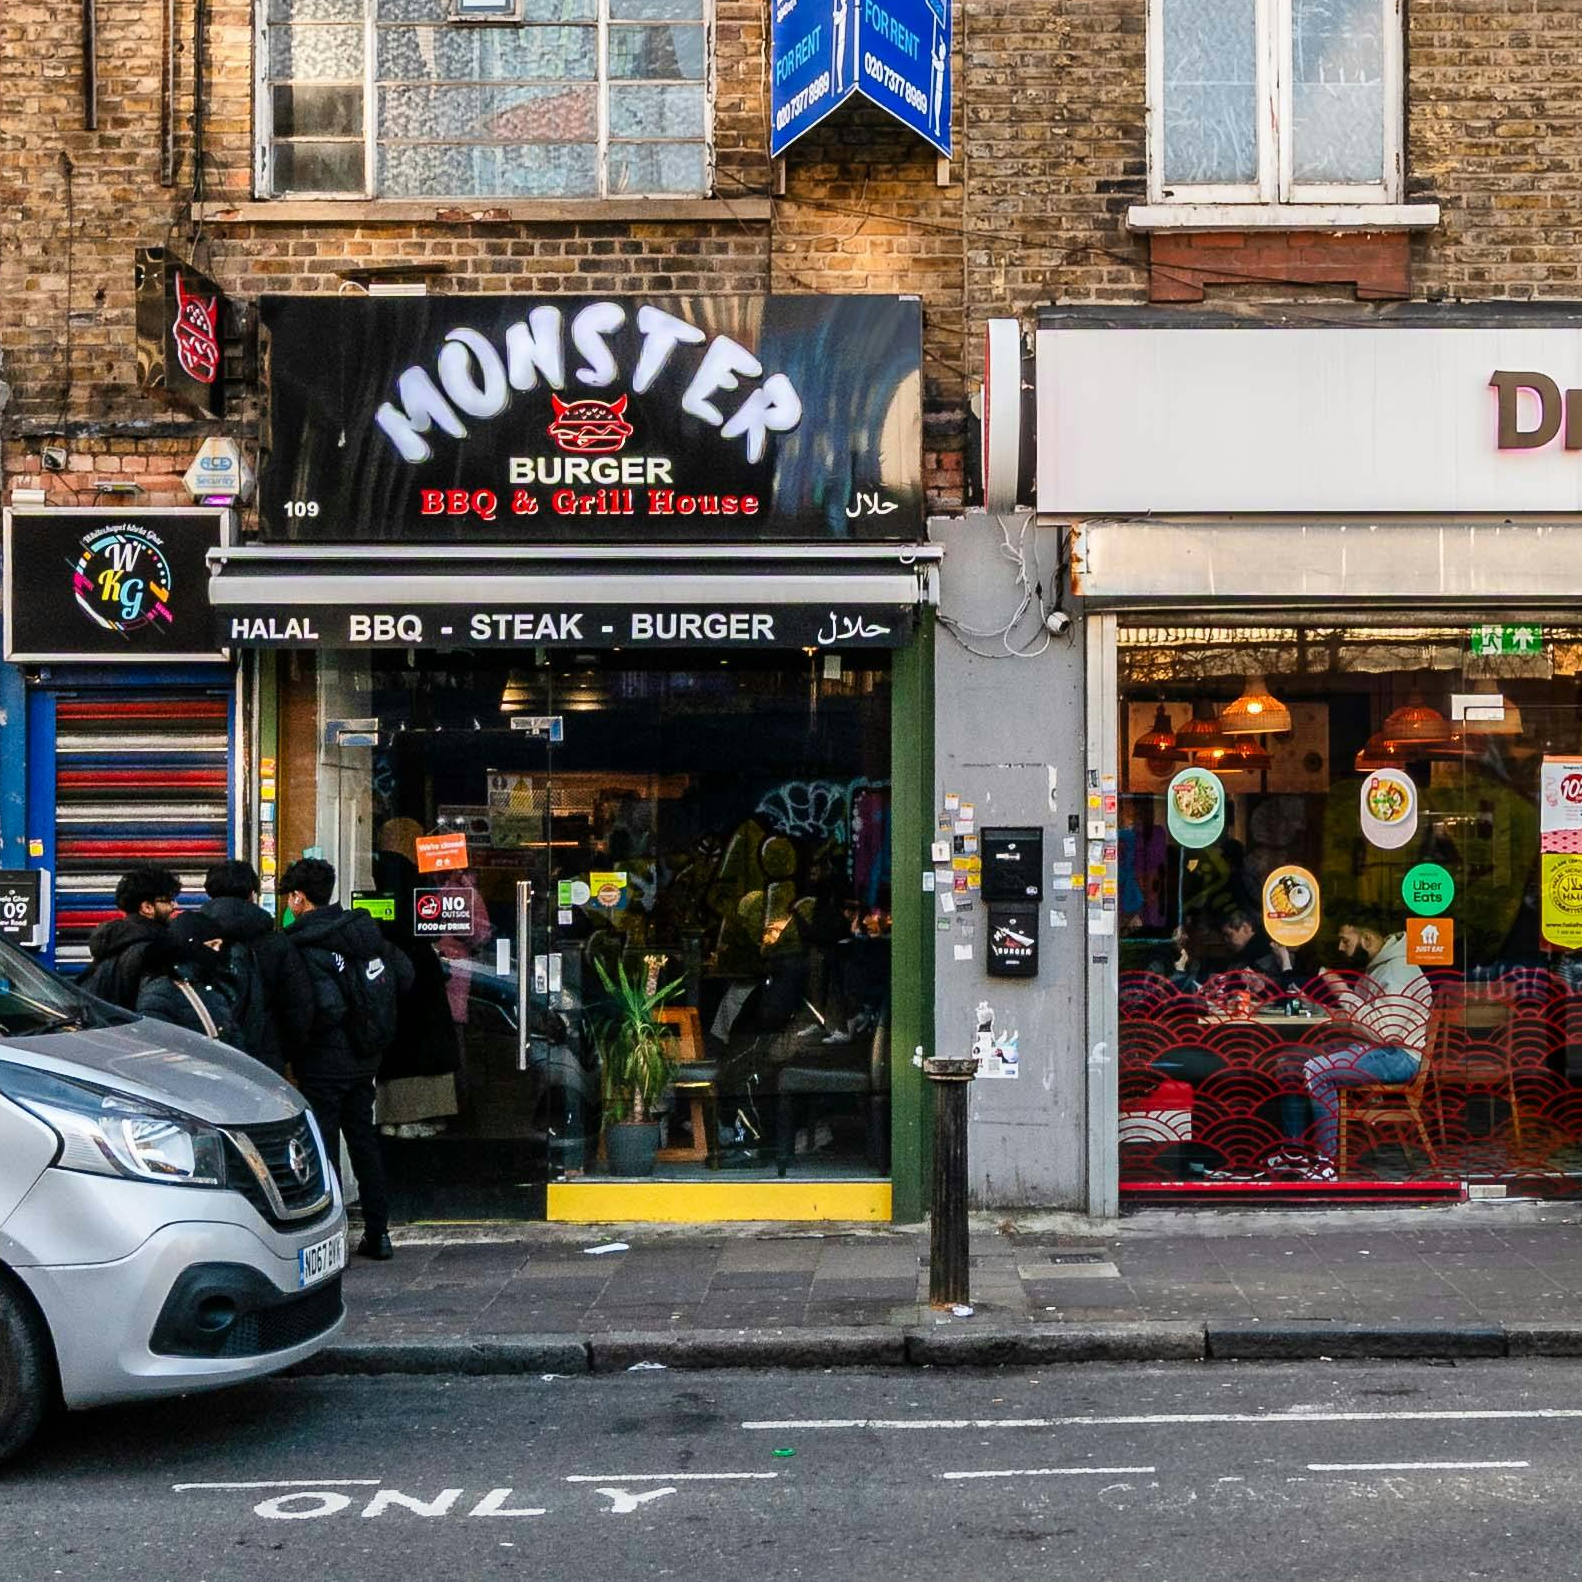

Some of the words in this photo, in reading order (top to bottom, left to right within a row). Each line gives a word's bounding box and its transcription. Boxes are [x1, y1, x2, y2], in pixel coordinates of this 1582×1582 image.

[890, 17, 920, 61] RENT
[777, 49, 794, 87] FOR
[795, 24, 822, 69] RENT
[864, 52, 883, 83] 020
[884, 65, 905, 97] 7377
[905, 82, 928, 114] 8989
[777, 103, 790, 131] 020
[790, 87, 809, 120] 7377
[374, 300, 805, 465] MONSTER
[200, 456, 233, 471] ACE
[508, 457, 674, 485] BURGER
[196, 476, 235, 486] Security
[284, 500, 319, 518] 109
[420, 488, 497, 520] BBQ
[511, 488, 539, 516] &
[551, 487, 634, 516] Grill
[647, 488, 760, 516] House
[845, 492, 899, 519] حلال
[230, 617, 319, 641] HALAL
[349, 614, 423, 643] BBQ
[470, 614, 584, 640] STEAK
[631, 614, 775, 640] BURGER
[818, 611, 891, 646] حلال
[419, 842, 439, 852] We're
[440, 840, 465, 850] closed
[1413, 880, 1442, 891] Uber
[1414, 892, 1442, 903] Eats
[442, 897, 465, 911] NO
[417, 923, 438, 931] FOOD
[439, 923, 447, 931] or
[998, 948, 1032, 956] BURGER
[305, 1243, 327, 1278] ND67
[253, 1487, 678, 1519] ONLY
